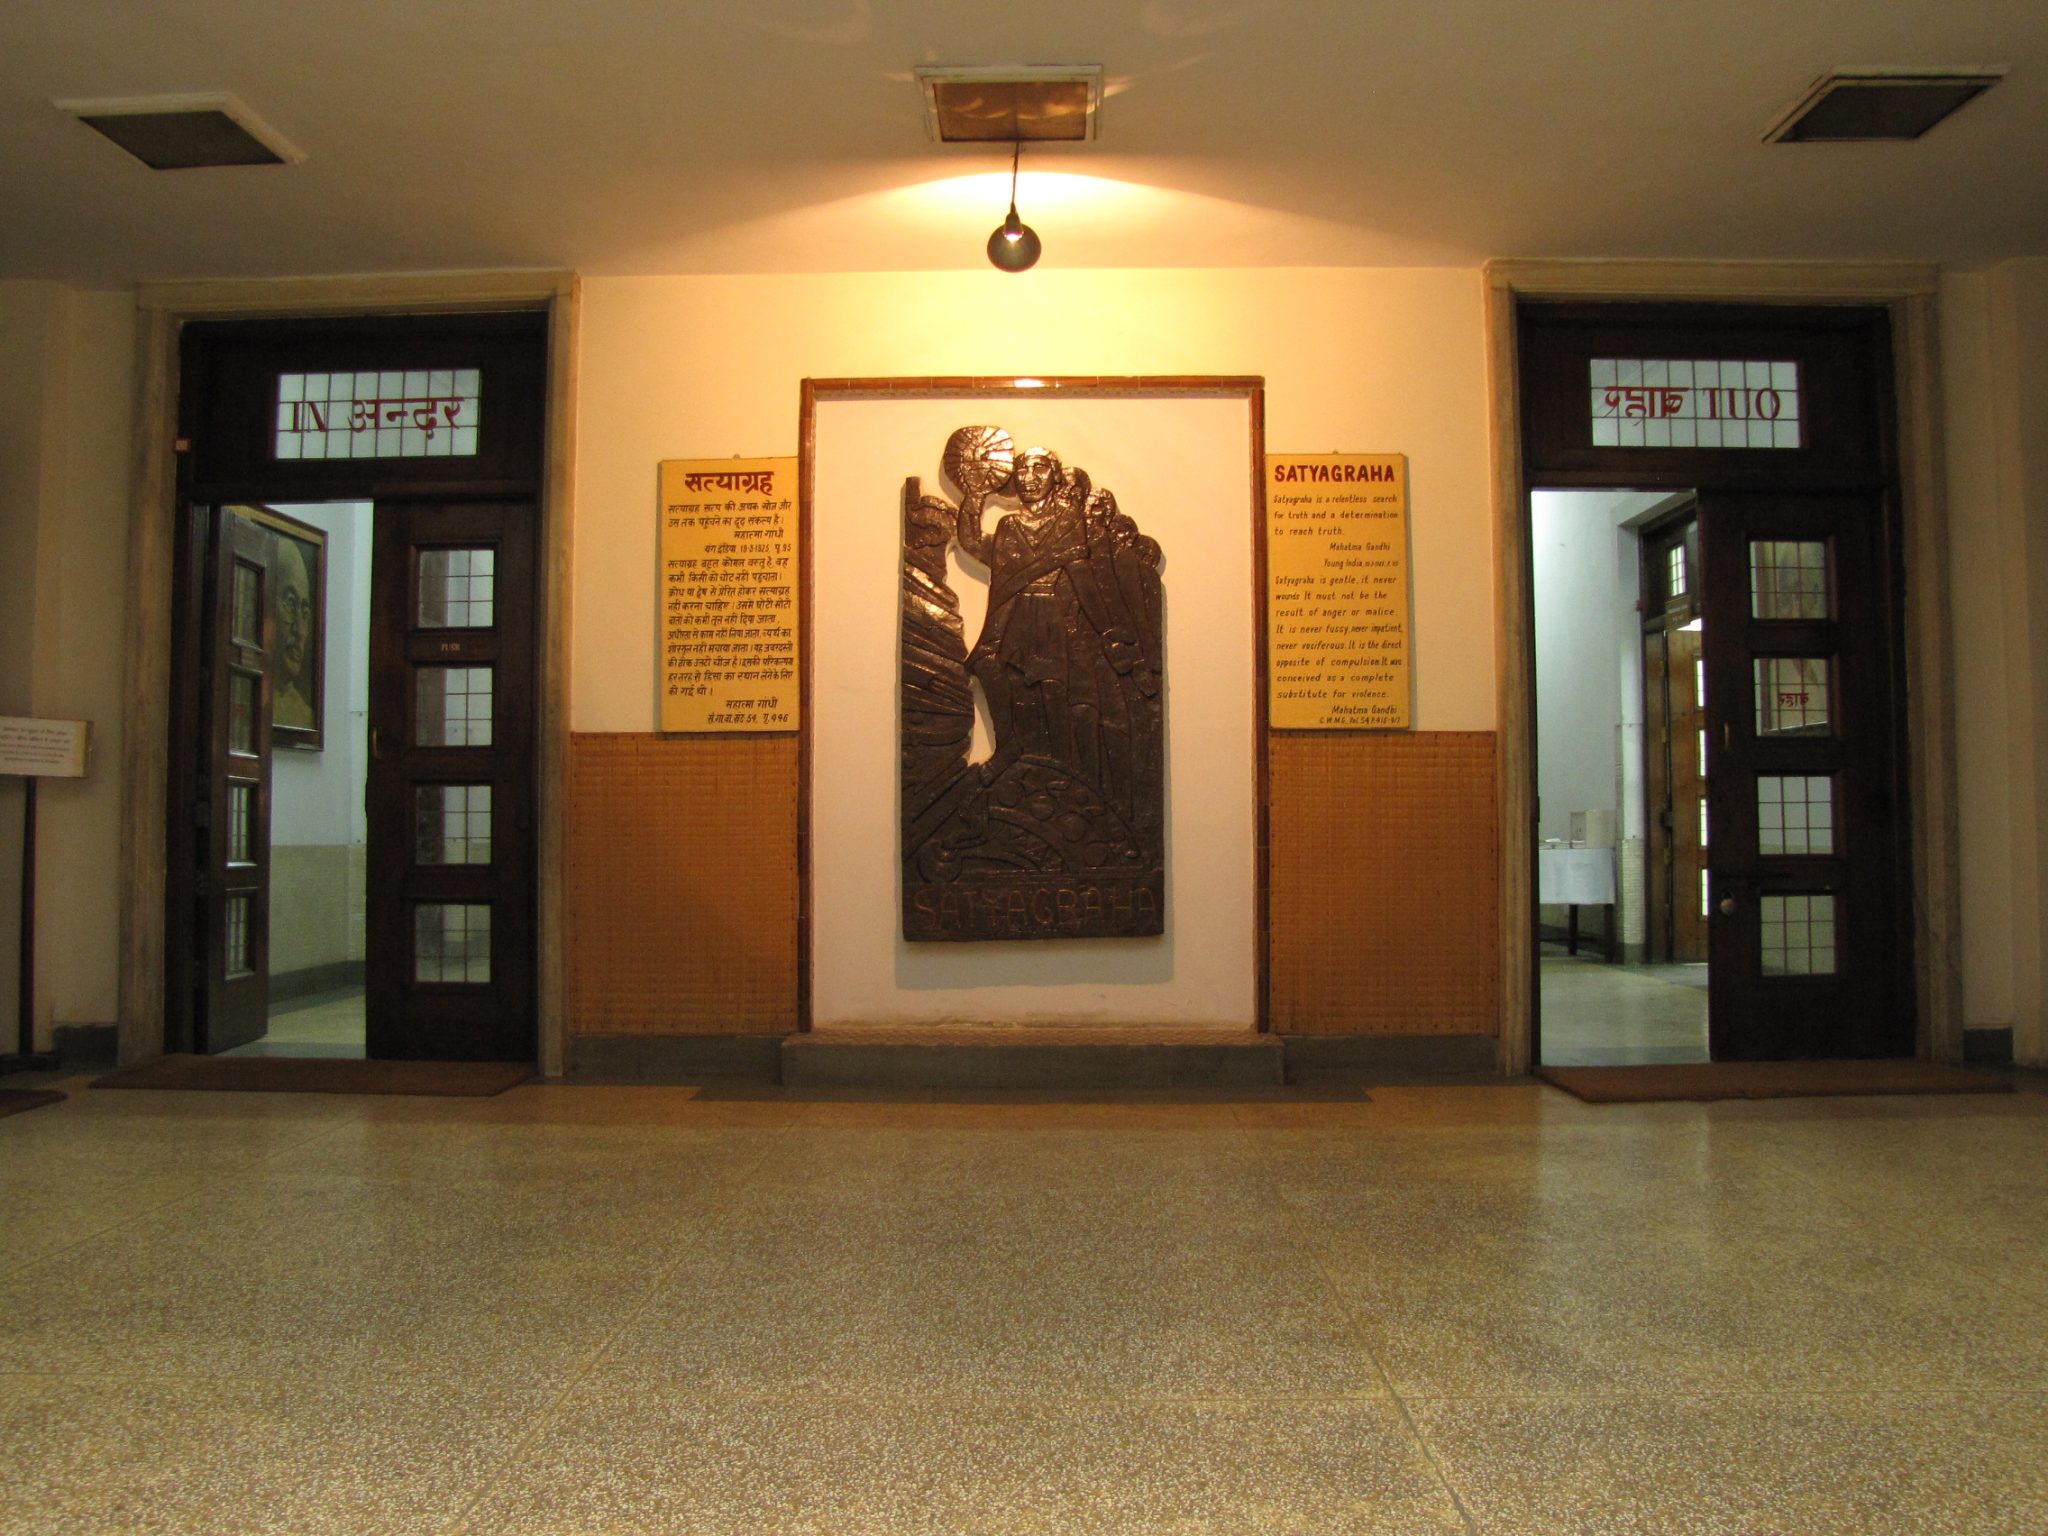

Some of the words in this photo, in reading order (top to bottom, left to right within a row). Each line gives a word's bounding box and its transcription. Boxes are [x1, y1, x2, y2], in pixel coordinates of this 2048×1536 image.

[291, 401, 328, 433] IN
[1274, 464, 1395, 482] SATYAGRAHA
[685, 471, 774, 495] सत्याग्रह
[1274, 495, 1312, 505] Satyagraha
[1316, 495, 1322, 503] is
[1332, 494, 1367, 503] relentless
[1373, 494, 1397, 502] search
[1274, 511, 1284, 519] for
[1289, 511, 1308, 519] truth
[1312, 511, 1326, 519] and
[1340, 511, 1398, 519] determination
[1275, 527, 1284, 535] to
[1290, 526, 1312, 535] reach
[1330, 543, 1361, 551] Mahatma
[1366, 542, 1390, 551] Gandhi
[1324, 560, 1344, 569] Young
[1275, 576, 1314, 586] Satyagraha
[1316, 592, 1336, 600] must
[1342, 592, 1354, 600] not
[1360, 591, 1369, 599] be
[1374, 590, 1387, 599] the
[1276, 608, 1304, 616] result
[1309, 608, 1319, 616] of
[1322, 609, 1346, 618] anger
[1276, 625, 1284, 634] It
[1348, 641, 1356, 649] It
[1368, 640, 1379, 649] the
[1382, 640, 1402, 648] direct
[1276, 658, 1310, 668] opposite
[1316, 658, 1325, 666] of
[1277, 674, 1321, 682] conceived
[1350, 673, 1394, 683] complete
[1277, 690, 1328, 698] substitute
[1333, 690, 1346, 698] for
[1332, 706, 1368, 714] Mahatma
[1371, 706, 1397, 714] Gandhi
[912, 884, 1157, 930] SATYAGRAHA
